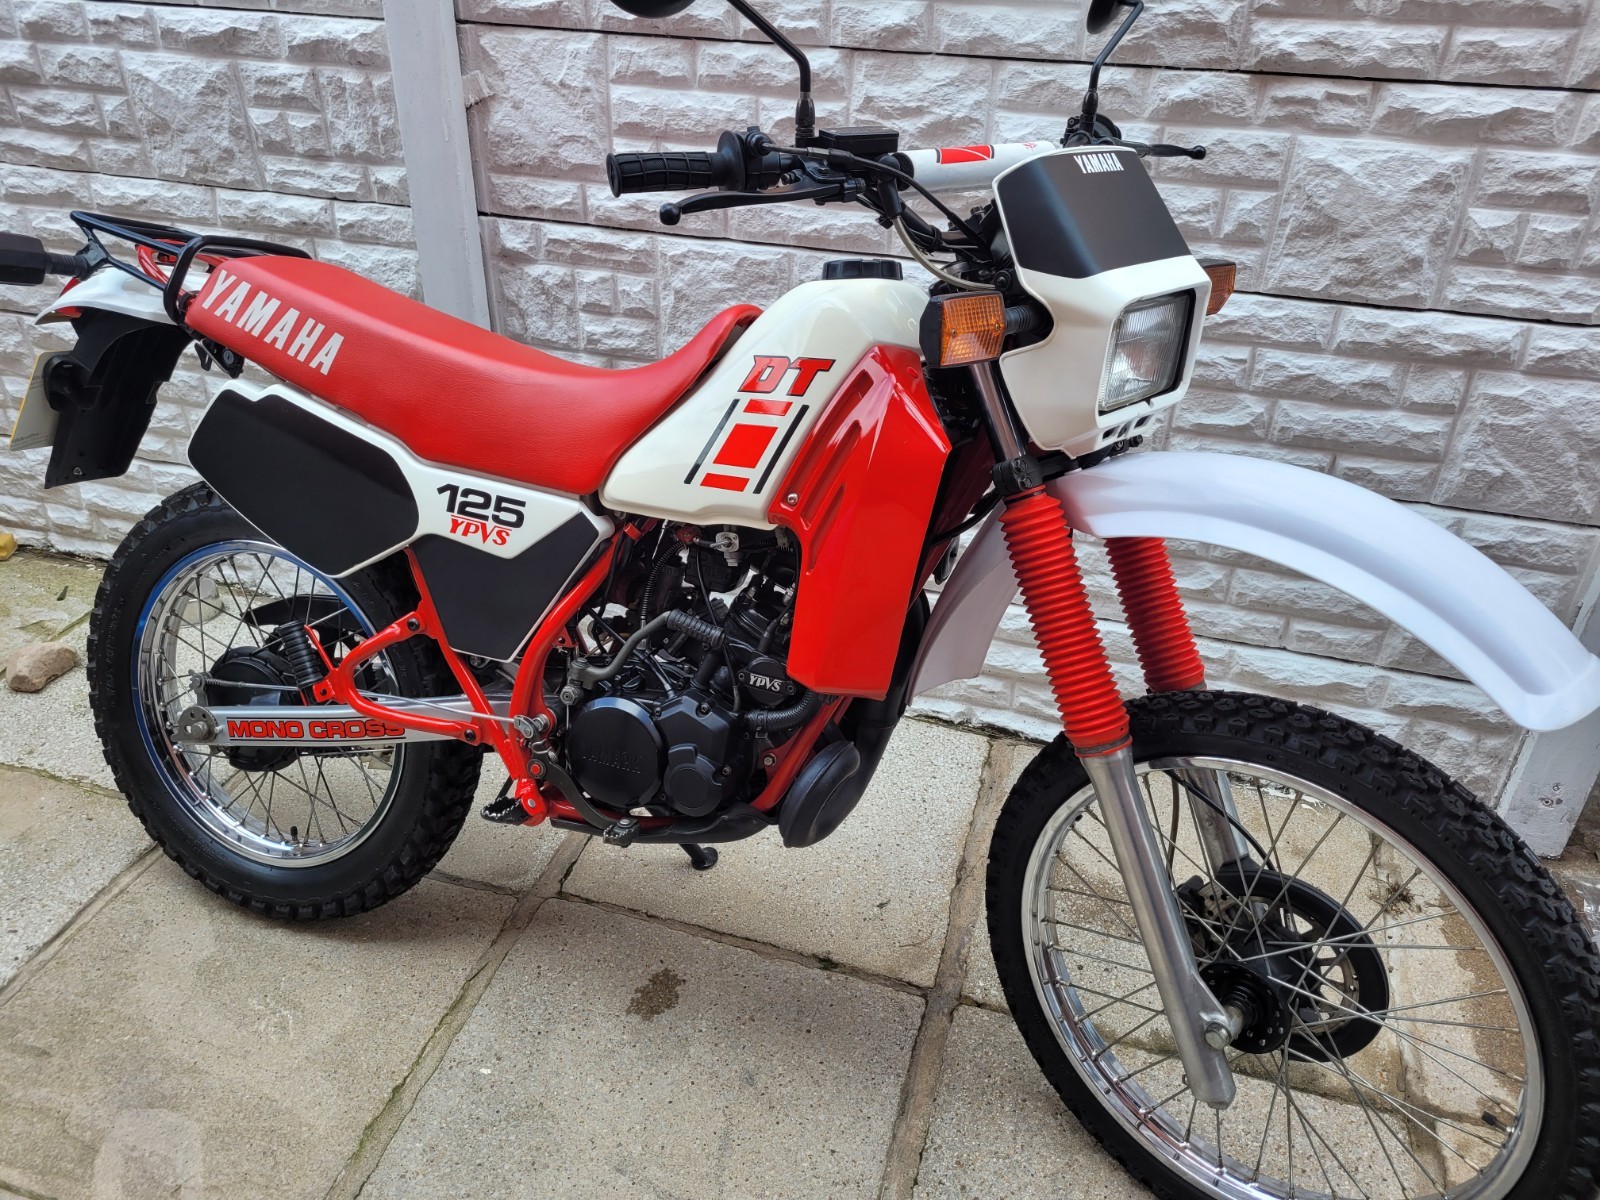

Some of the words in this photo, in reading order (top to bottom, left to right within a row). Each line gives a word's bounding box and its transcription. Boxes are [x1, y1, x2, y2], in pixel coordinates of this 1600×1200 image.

[1073, 153, 1124, 174] YAMAHA
[202, 269, 344, 376] YAMAHA
[737, 355, 836, 397] DT
[437, 483, 526, 529] 125
[449, 514, 512, 546] YPVS
[749, 673, 783, 691] YPVS
[227, 720, 304, 739] MONO
